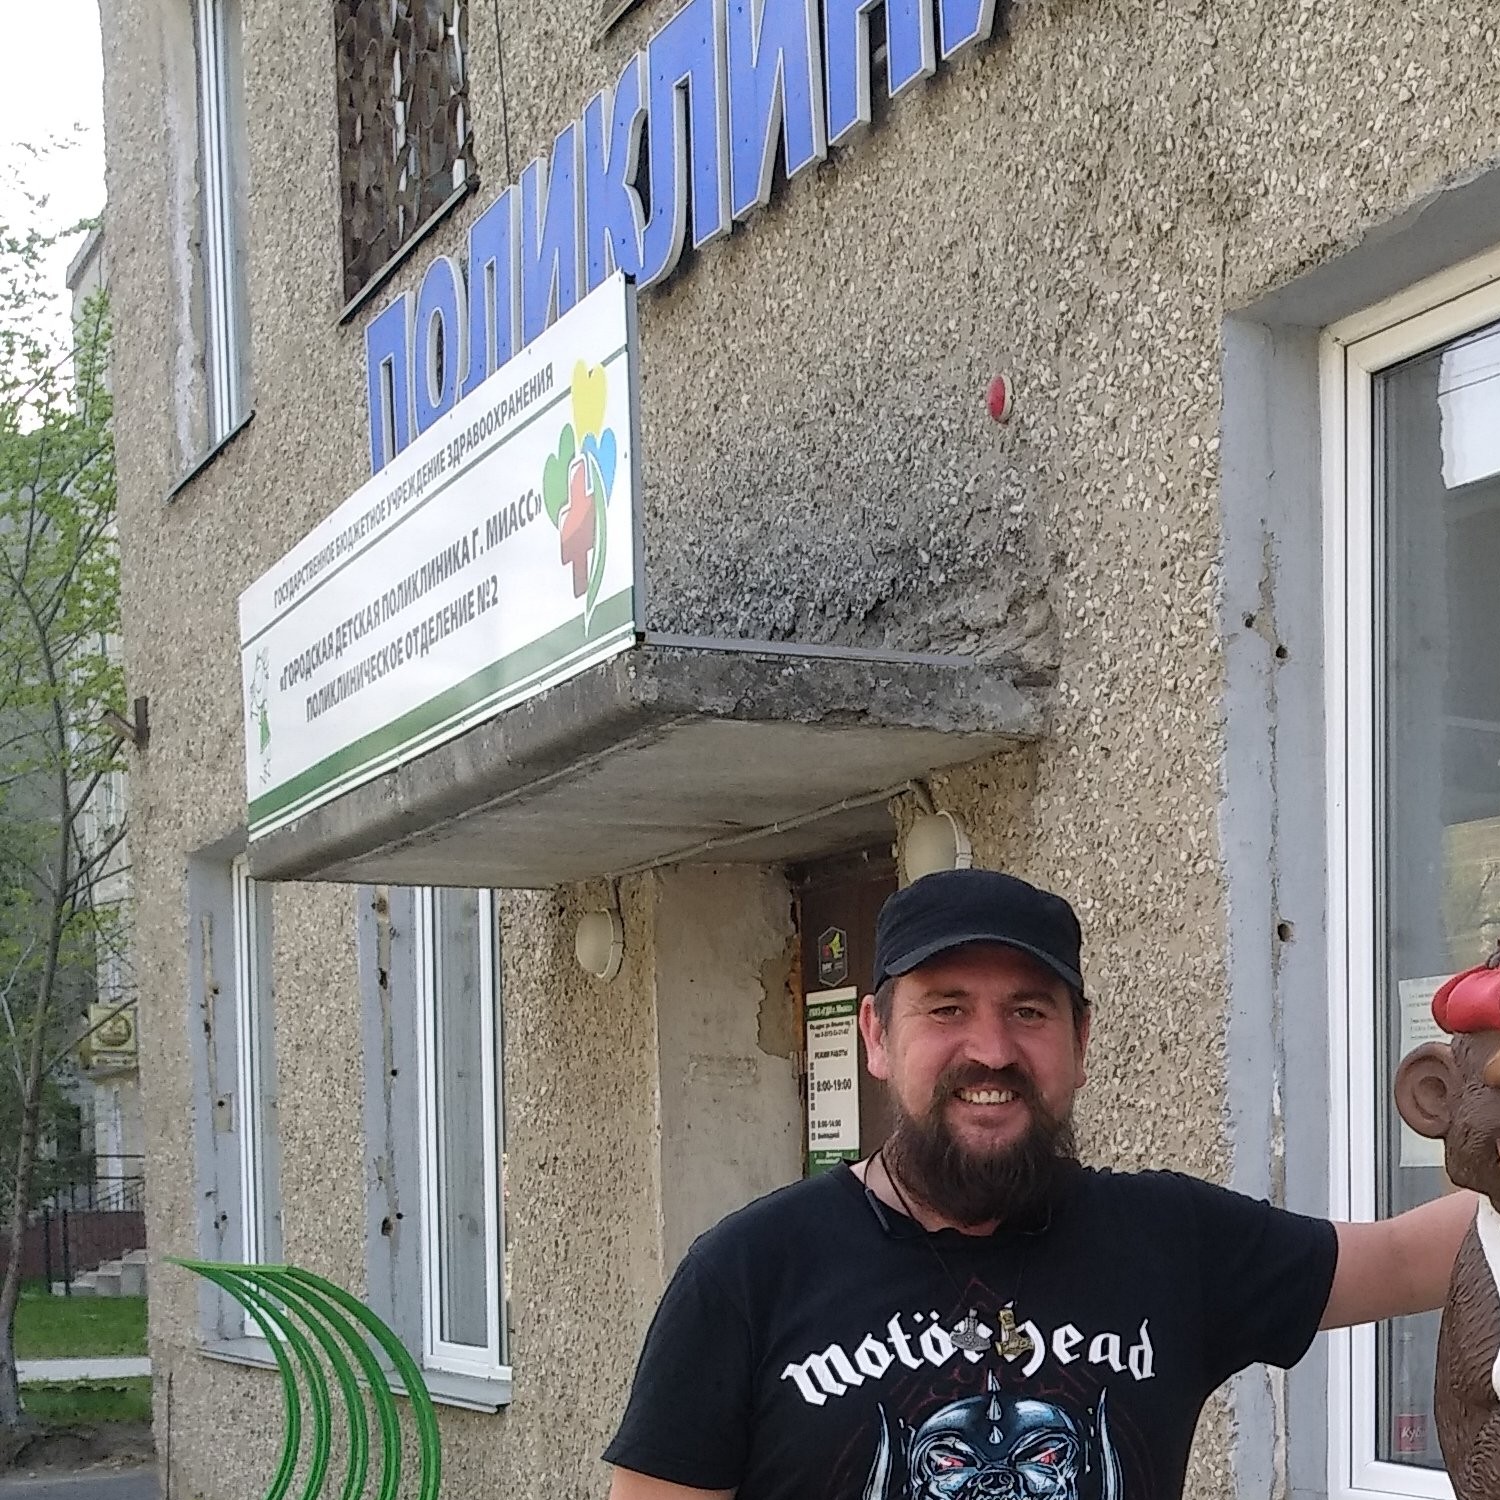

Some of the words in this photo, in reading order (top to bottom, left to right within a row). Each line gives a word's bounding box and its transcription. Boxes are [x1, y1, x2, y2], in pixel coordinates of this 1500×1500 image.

[365, 0, 994, 478] ПОЛИКЛИ
[273, 540, 335, 608] ГОСУДАРСТВЕННОЕ
[335, 499, 386, 557] БЮДЖЕТНОЕ
[386, 449, 446, 516] УЧРЕЖДЕНИЕ
[446, 362, 554, 468] ЗДРАВООХРАНЕНИЯ
[279, 631, 334, 692] «ГОРОДСКАЯ
[334, 599, 381, 659] ДЕТСКАЯ
[381, 535, 471, 623] ПОЛИКЛИНИКА
[472, 527, 484, 560] Г.
[486, 488, 542, 551] МИАСС»
[306, 637, 404, 722] ПОЛИКЛИНИЧЕСКОЕ
[405, 588, 475, 659] ОТДЕЛЕНИЕ
[477, 574, 499, 616] №2
[816, 1078, 852, 1092] 8:00-19:00
